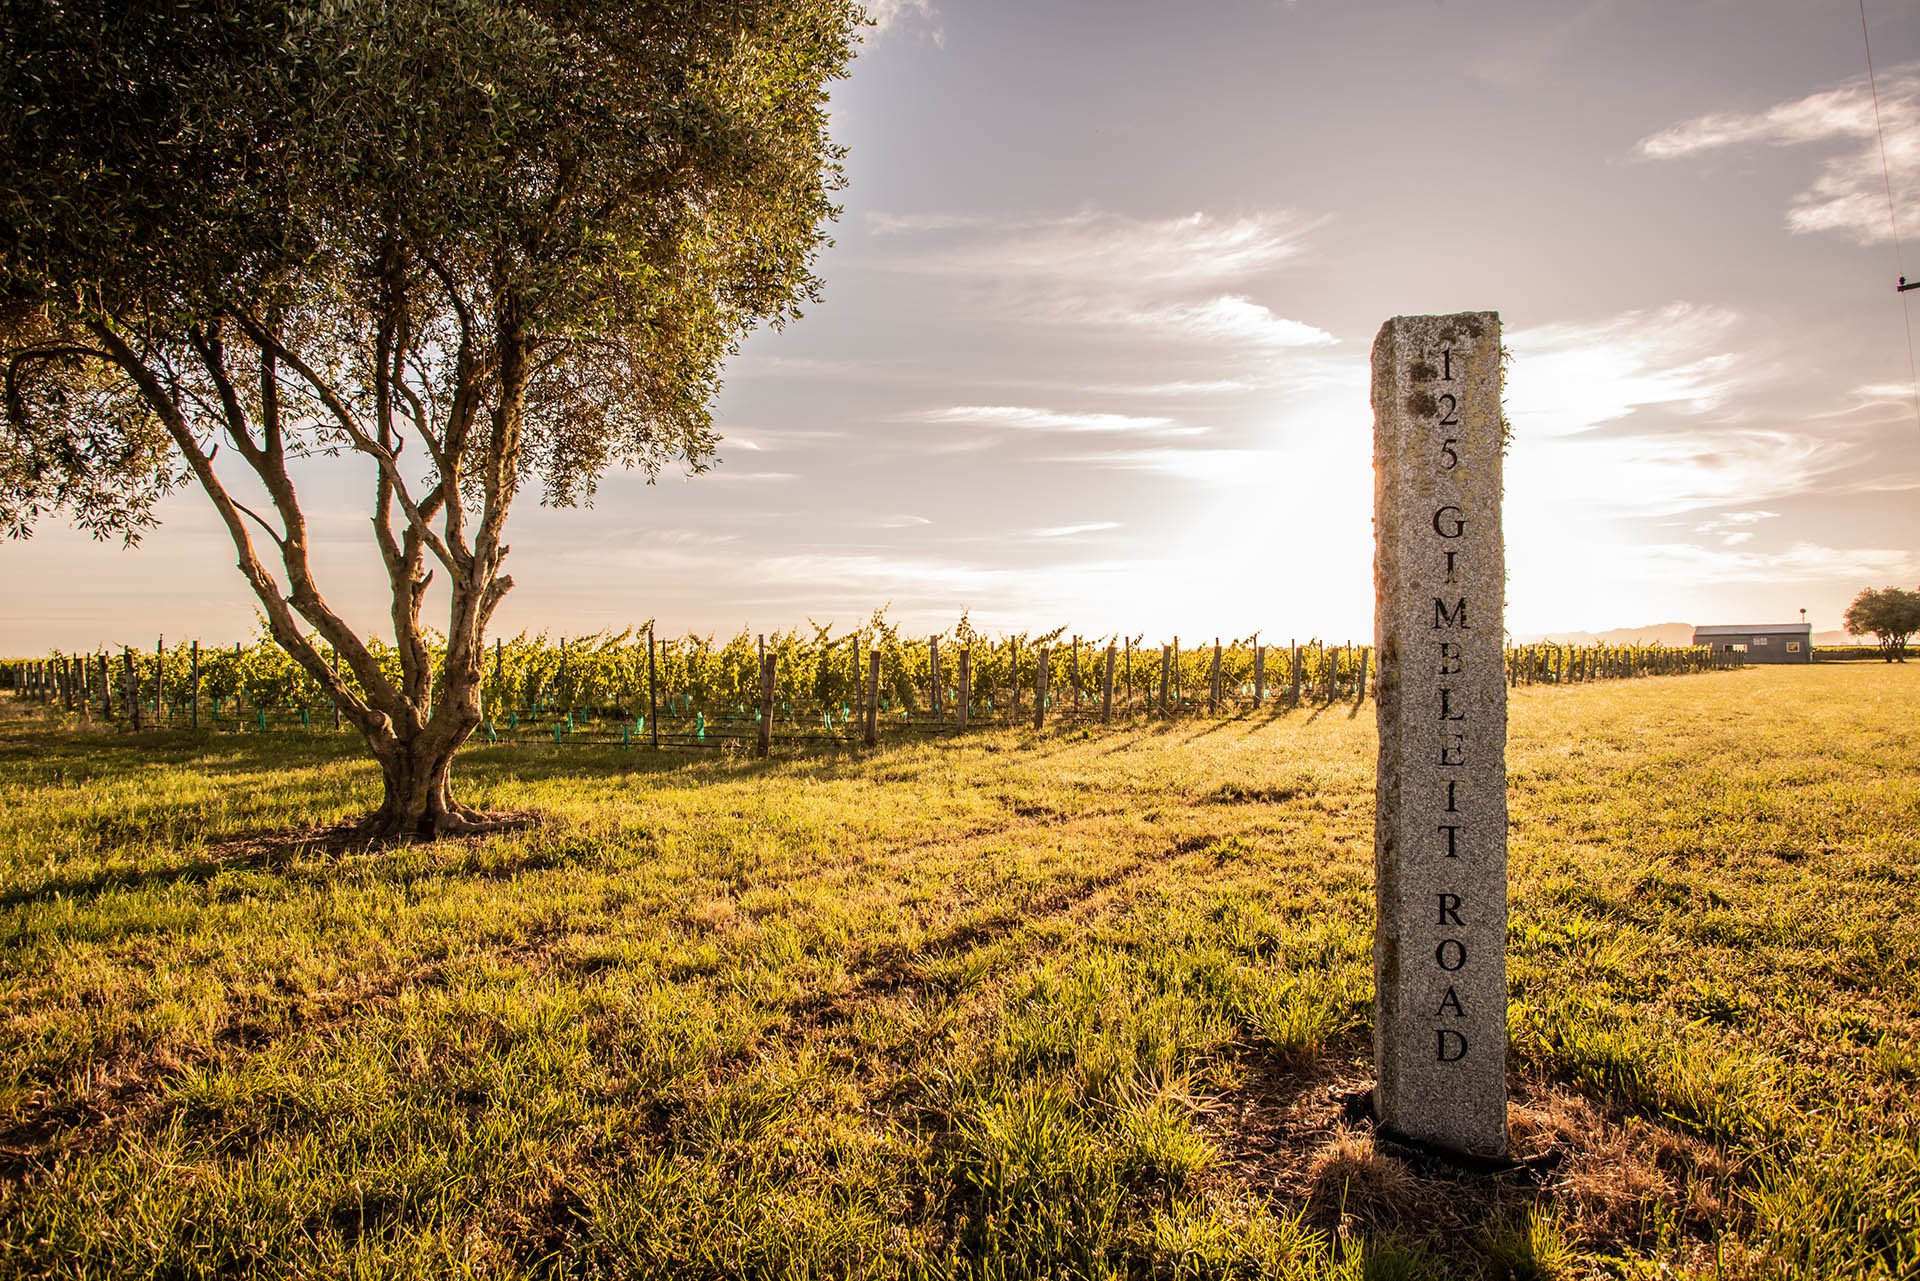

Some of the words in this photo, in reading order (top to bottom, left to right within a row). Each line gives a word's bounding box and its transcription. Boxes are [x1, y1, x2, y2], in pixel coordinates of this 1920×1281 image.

[1438, 348, 1459, 470] 125
[1432, 506, 1471, 858] GIMBLETT
[1432, 892, 1468, 1062] ROAD
